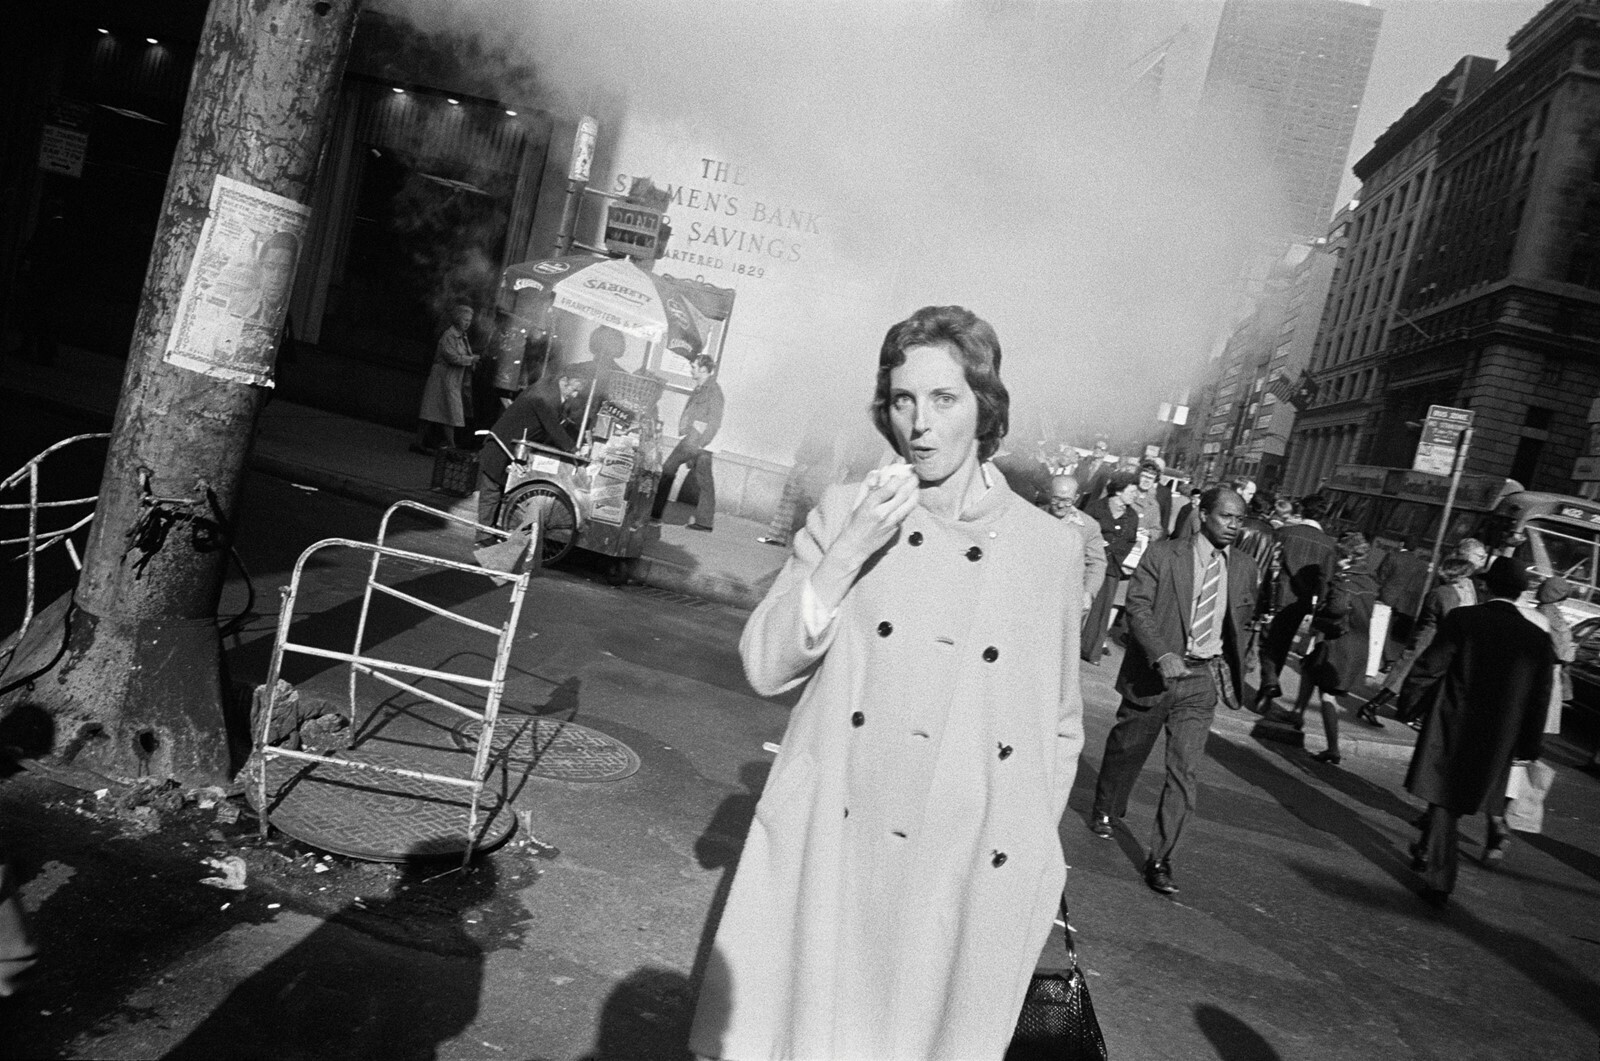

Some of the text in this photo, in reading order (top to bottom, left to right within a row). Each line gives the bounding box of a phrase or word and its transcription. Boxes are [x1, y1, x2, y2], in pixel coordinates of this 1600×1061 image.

[701, 157, 747, 186] THE
[614, 173, 823, 235] SMEN'S BANK
[688, 221, 802, 263] SAVINGS
[663, 248, 766, 279] ARTERED 1829
[583, 278, 652, 303] SABRETT
[561, 297, 622, 325] FRANKFURTERS
